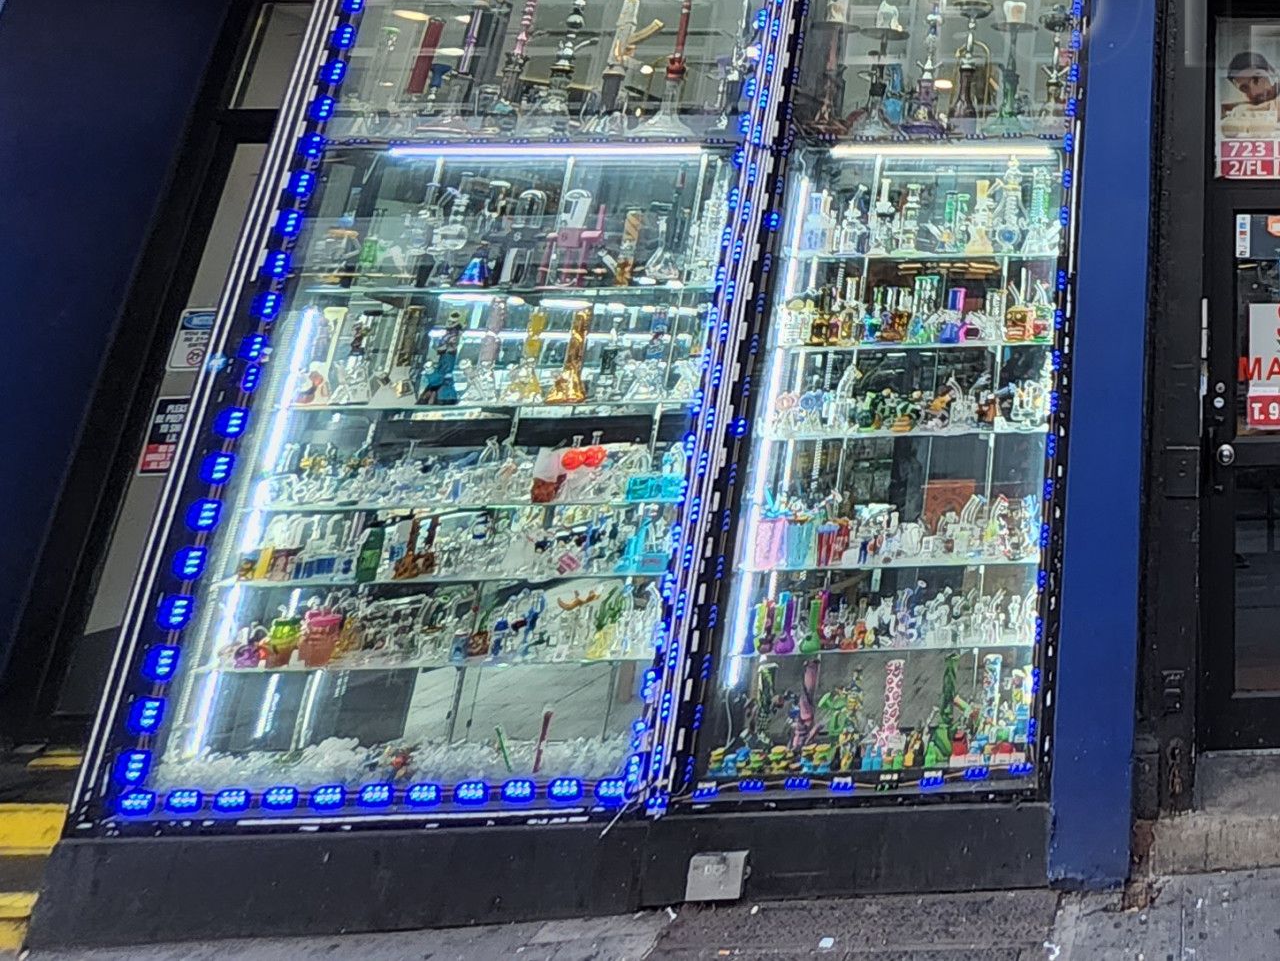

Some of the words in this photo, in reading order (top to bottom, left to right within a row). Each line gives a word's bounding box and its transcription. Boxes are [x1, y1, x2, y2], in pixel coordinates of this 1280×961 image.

[1229, 142, 1267, 157] 723
[1228, 161, 1268, 176] 2/FL
[1252, 403, 1265, 419] T.
